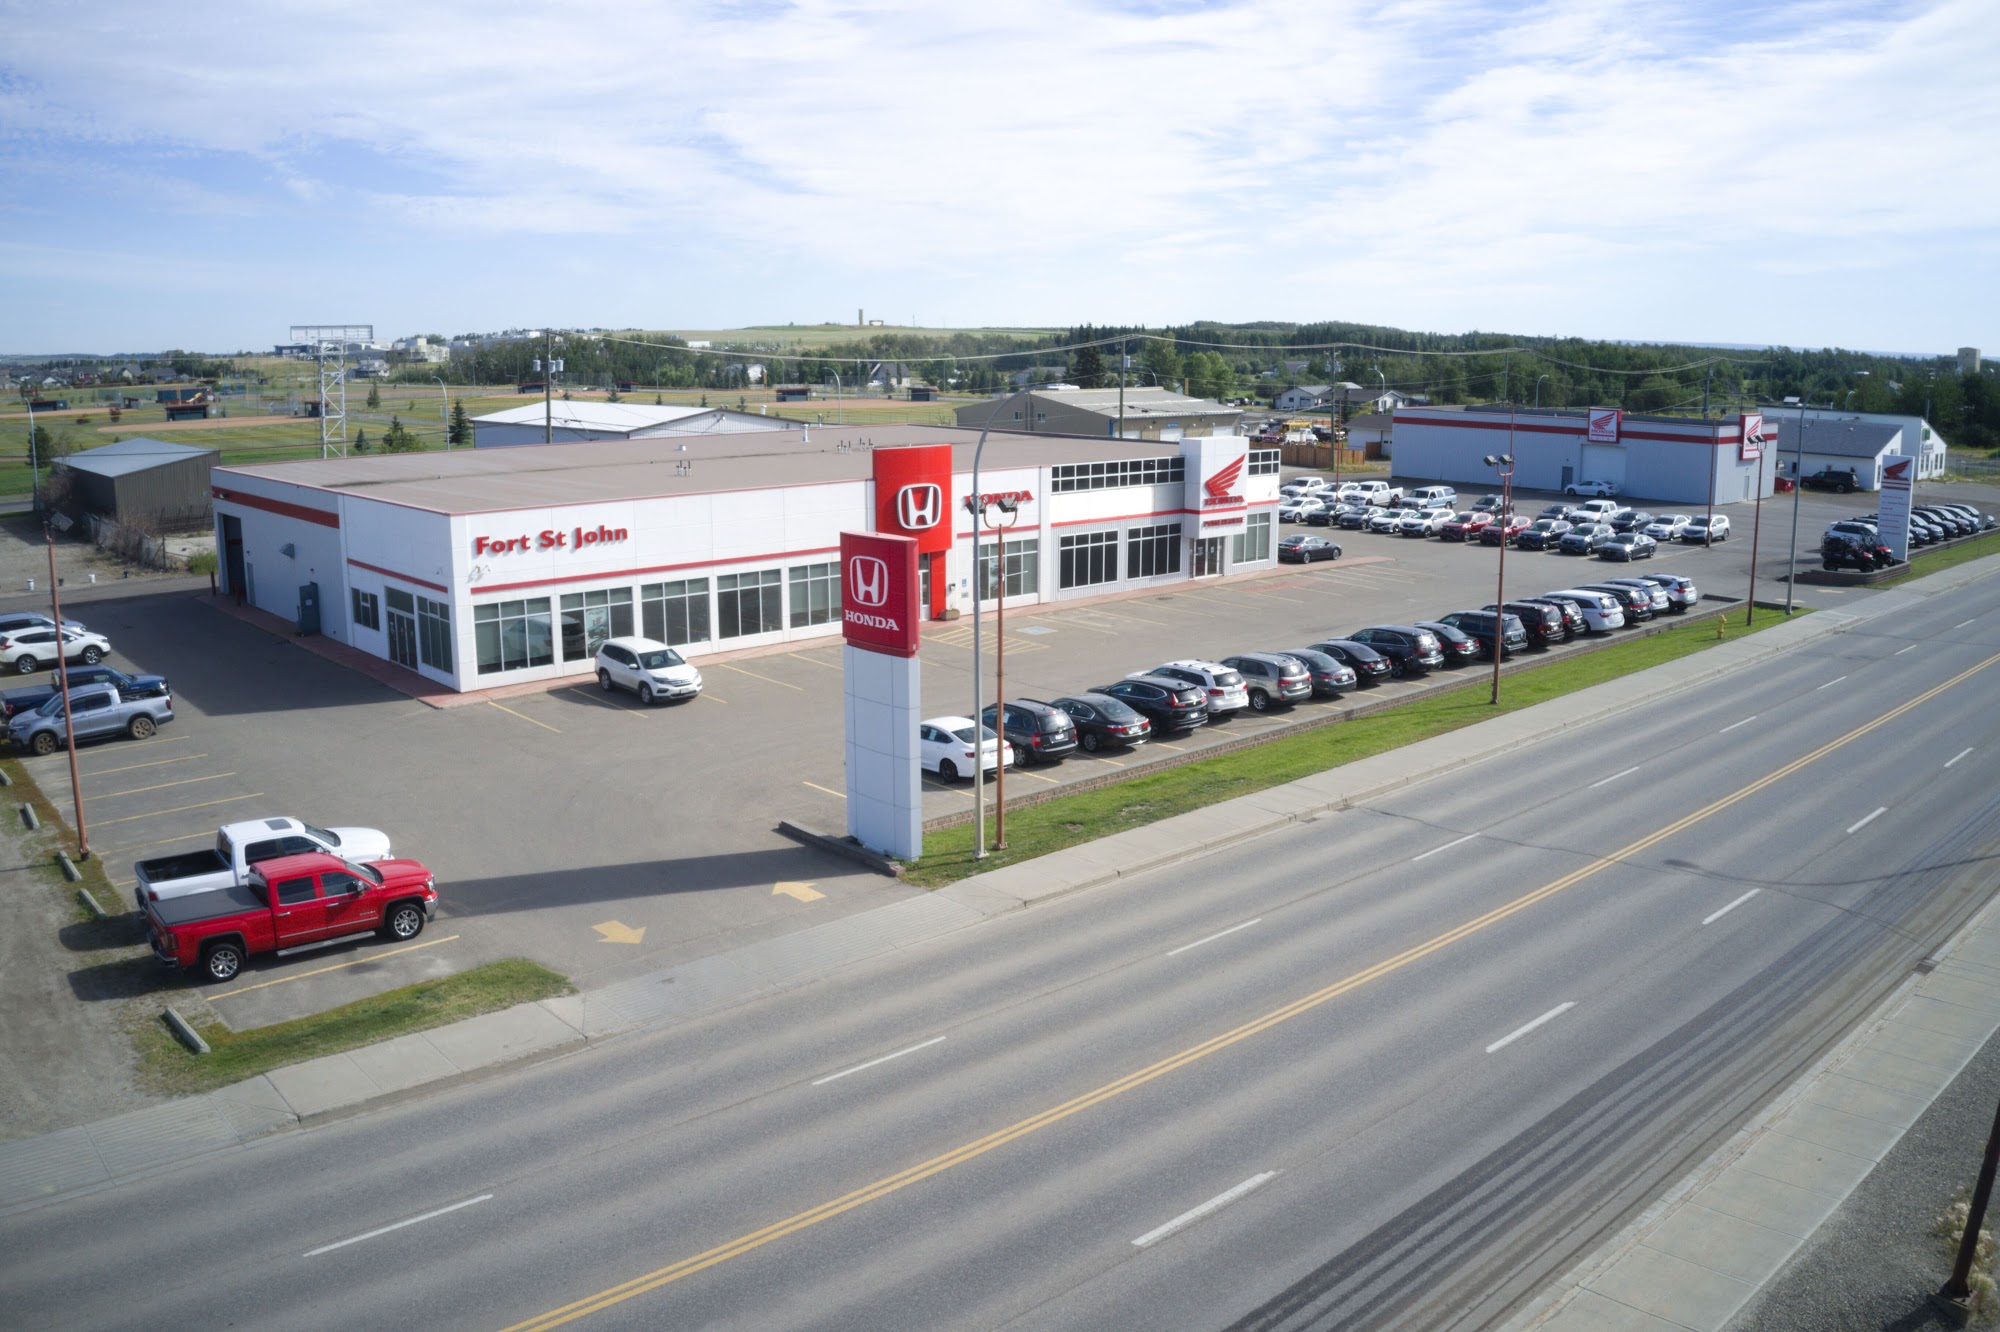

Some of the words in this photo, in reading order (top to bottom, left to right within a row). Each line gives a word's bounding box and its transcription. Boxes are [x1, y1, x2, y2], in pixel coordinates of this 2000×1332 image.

[476, 535, 531, 555] Fort
[540, 530, 567, 549] St
[574, 525, 628, 550] John
[844, 609, 900, 631] HONDA
